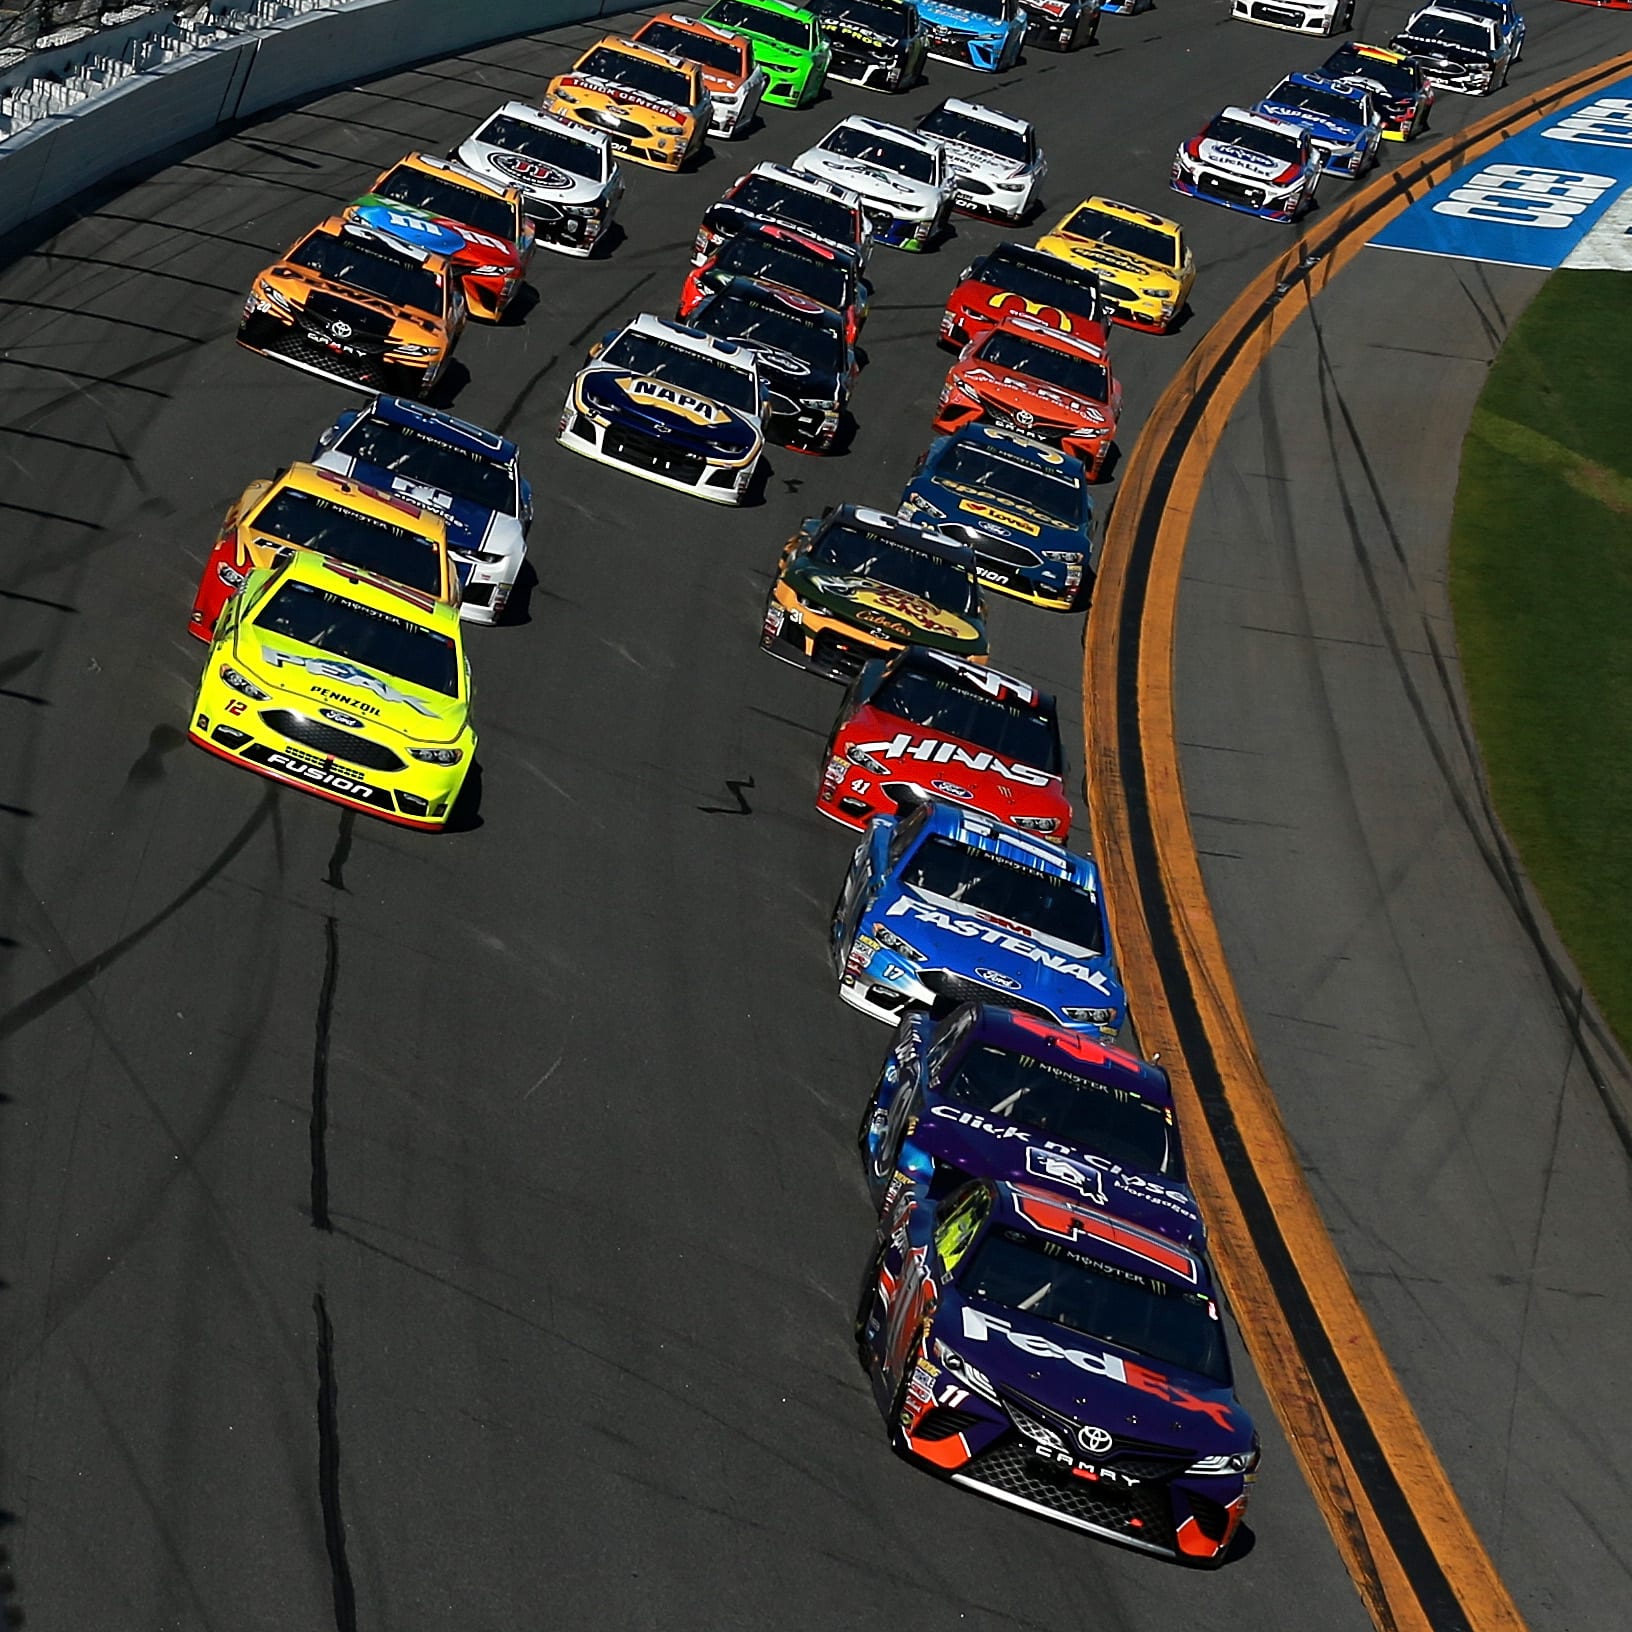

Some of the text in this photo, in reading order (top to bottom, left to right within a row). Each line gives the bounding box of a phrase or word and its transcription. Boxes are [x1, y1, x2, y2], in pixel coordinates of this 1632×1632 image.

[1432, 164, 1618, 228] GEICO
[256, 300, 272, 314] 20
[632, 379, 716, 421] NAPA
[340, 597, 402, 627] MONSTER
[260, 644, 444, 721] PEAK
[224, 698, 248, 717] 12
[310, 685, 382, 718] PENNZOIL
[324, 708, 357, 728] Ford
[267, 753, 374, 799] FUSION
[850, 778, 871, 795] 41
[885, 893, 1112, 998] FASTENAL
[883, 963, 905, 981] 17
[1038, 1062, 1110, 1094] MONSTER
[930, 1104, 1034, 1145] Click
[1084, 1153, 1190, 1205] Close
[1114, 1179, 1199, 1221] Mortgages
[1066, 1250, 1146, 1286] MONSTER
[960, 1304, 1236, 1434] FedEx
[938, 1384, 970, 1408] 11
[1035, 1444, 1142, 1488] CAMRY
